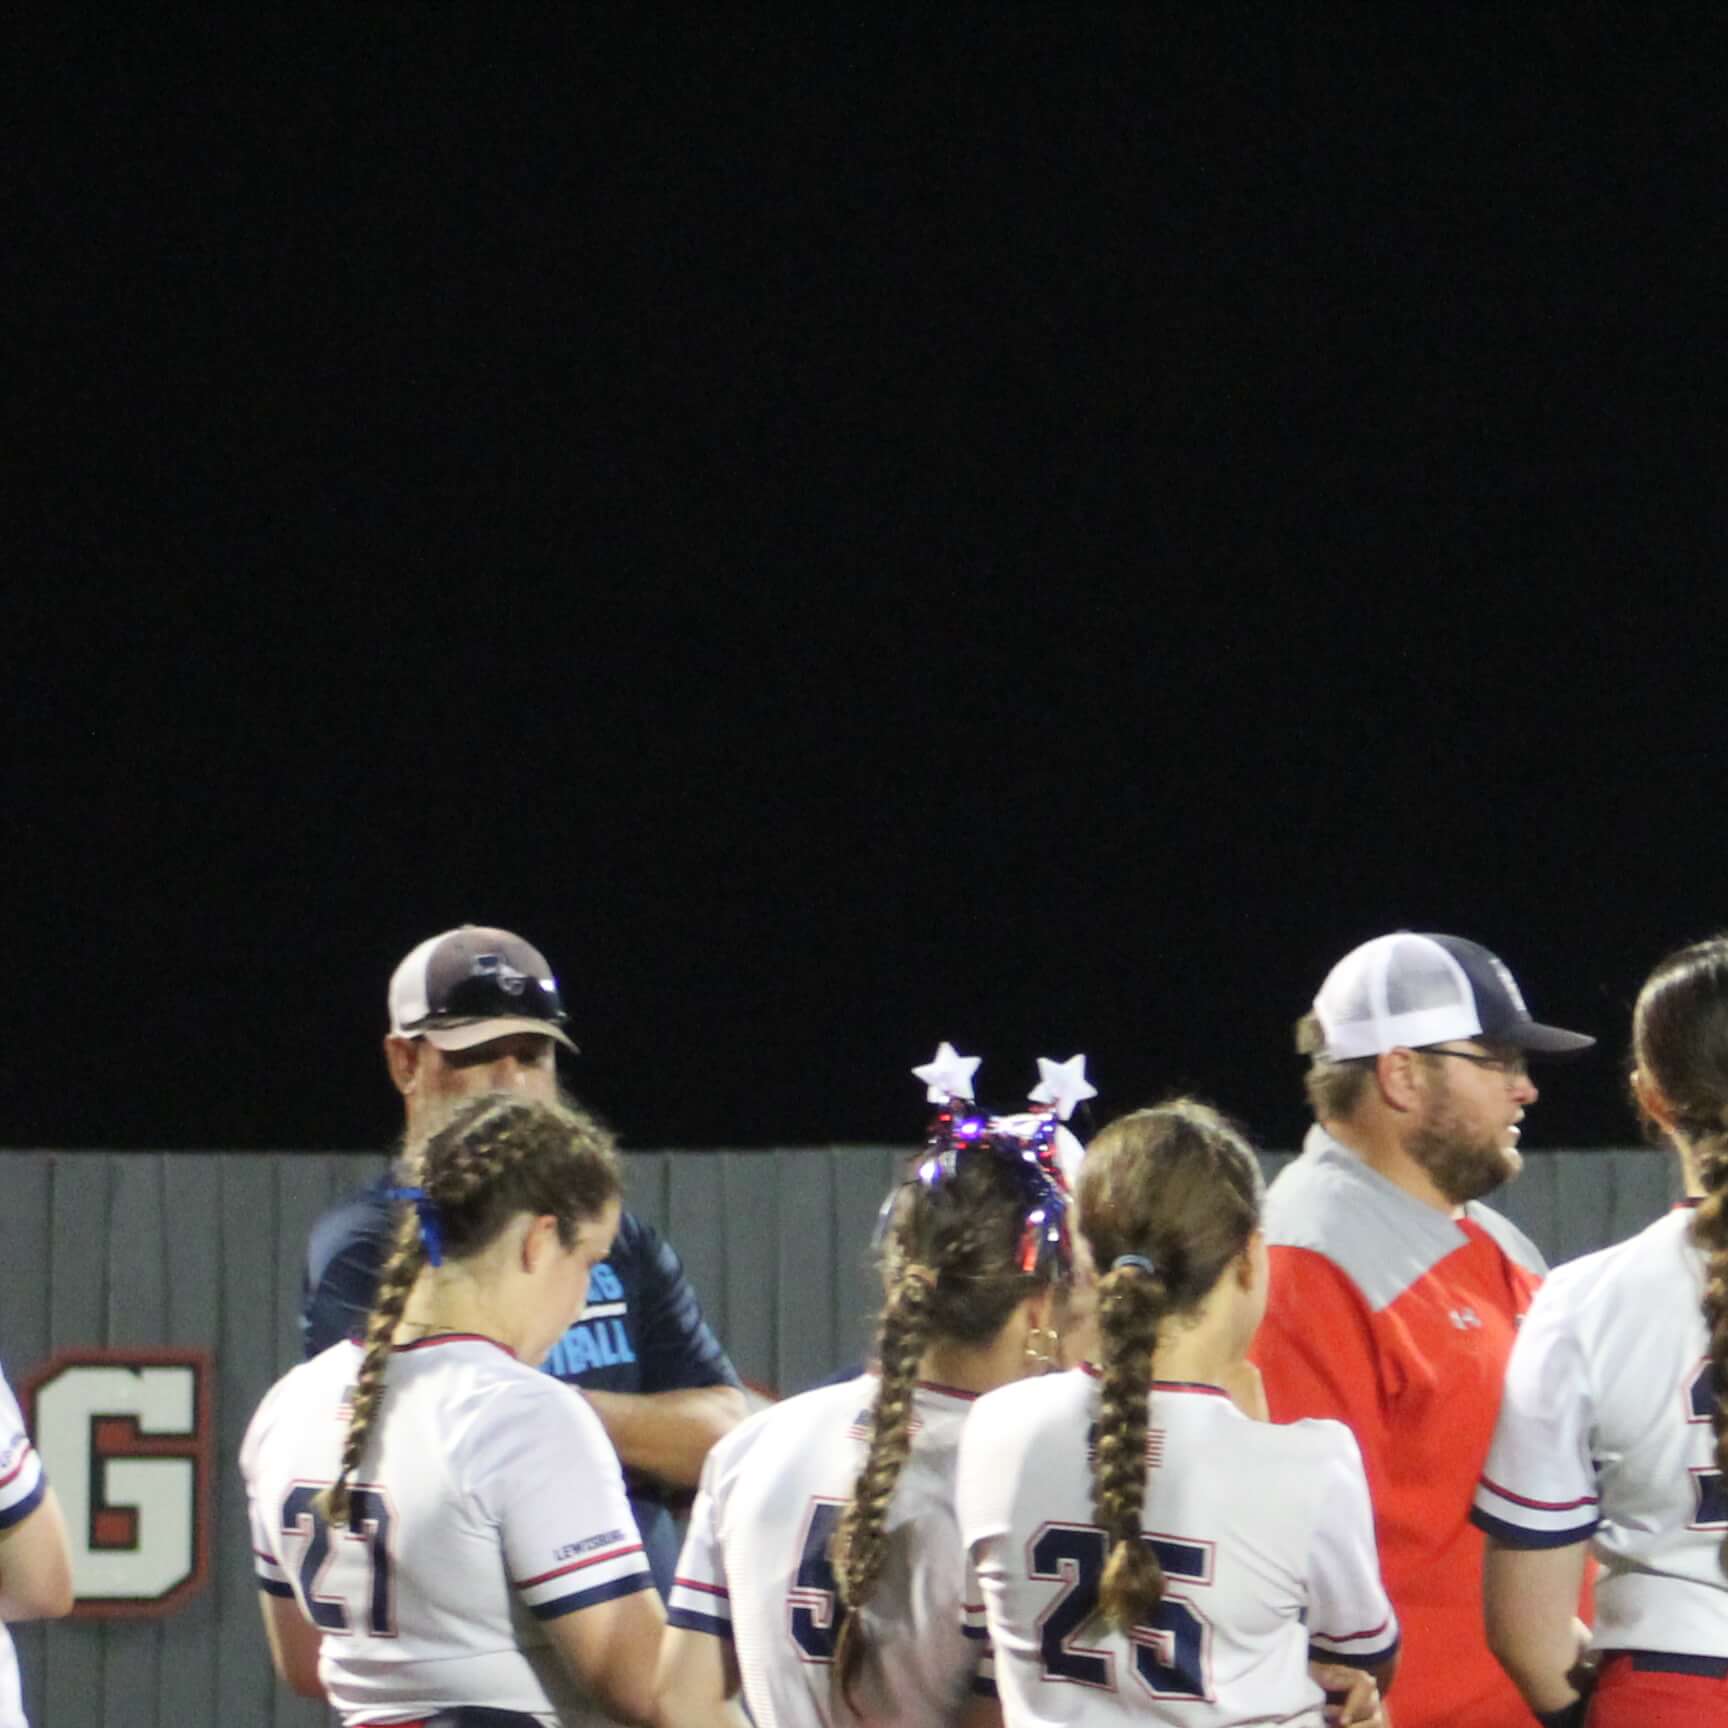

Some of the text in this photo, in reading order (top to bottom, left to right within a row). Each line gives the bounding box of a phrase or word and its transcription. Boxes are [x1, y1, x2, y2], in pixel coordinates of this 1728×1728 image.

[31, 1356, 203, 1607] G
[278, 1478, 401, 1638] 27
[1025, 1520, 1217, 1704] 25
